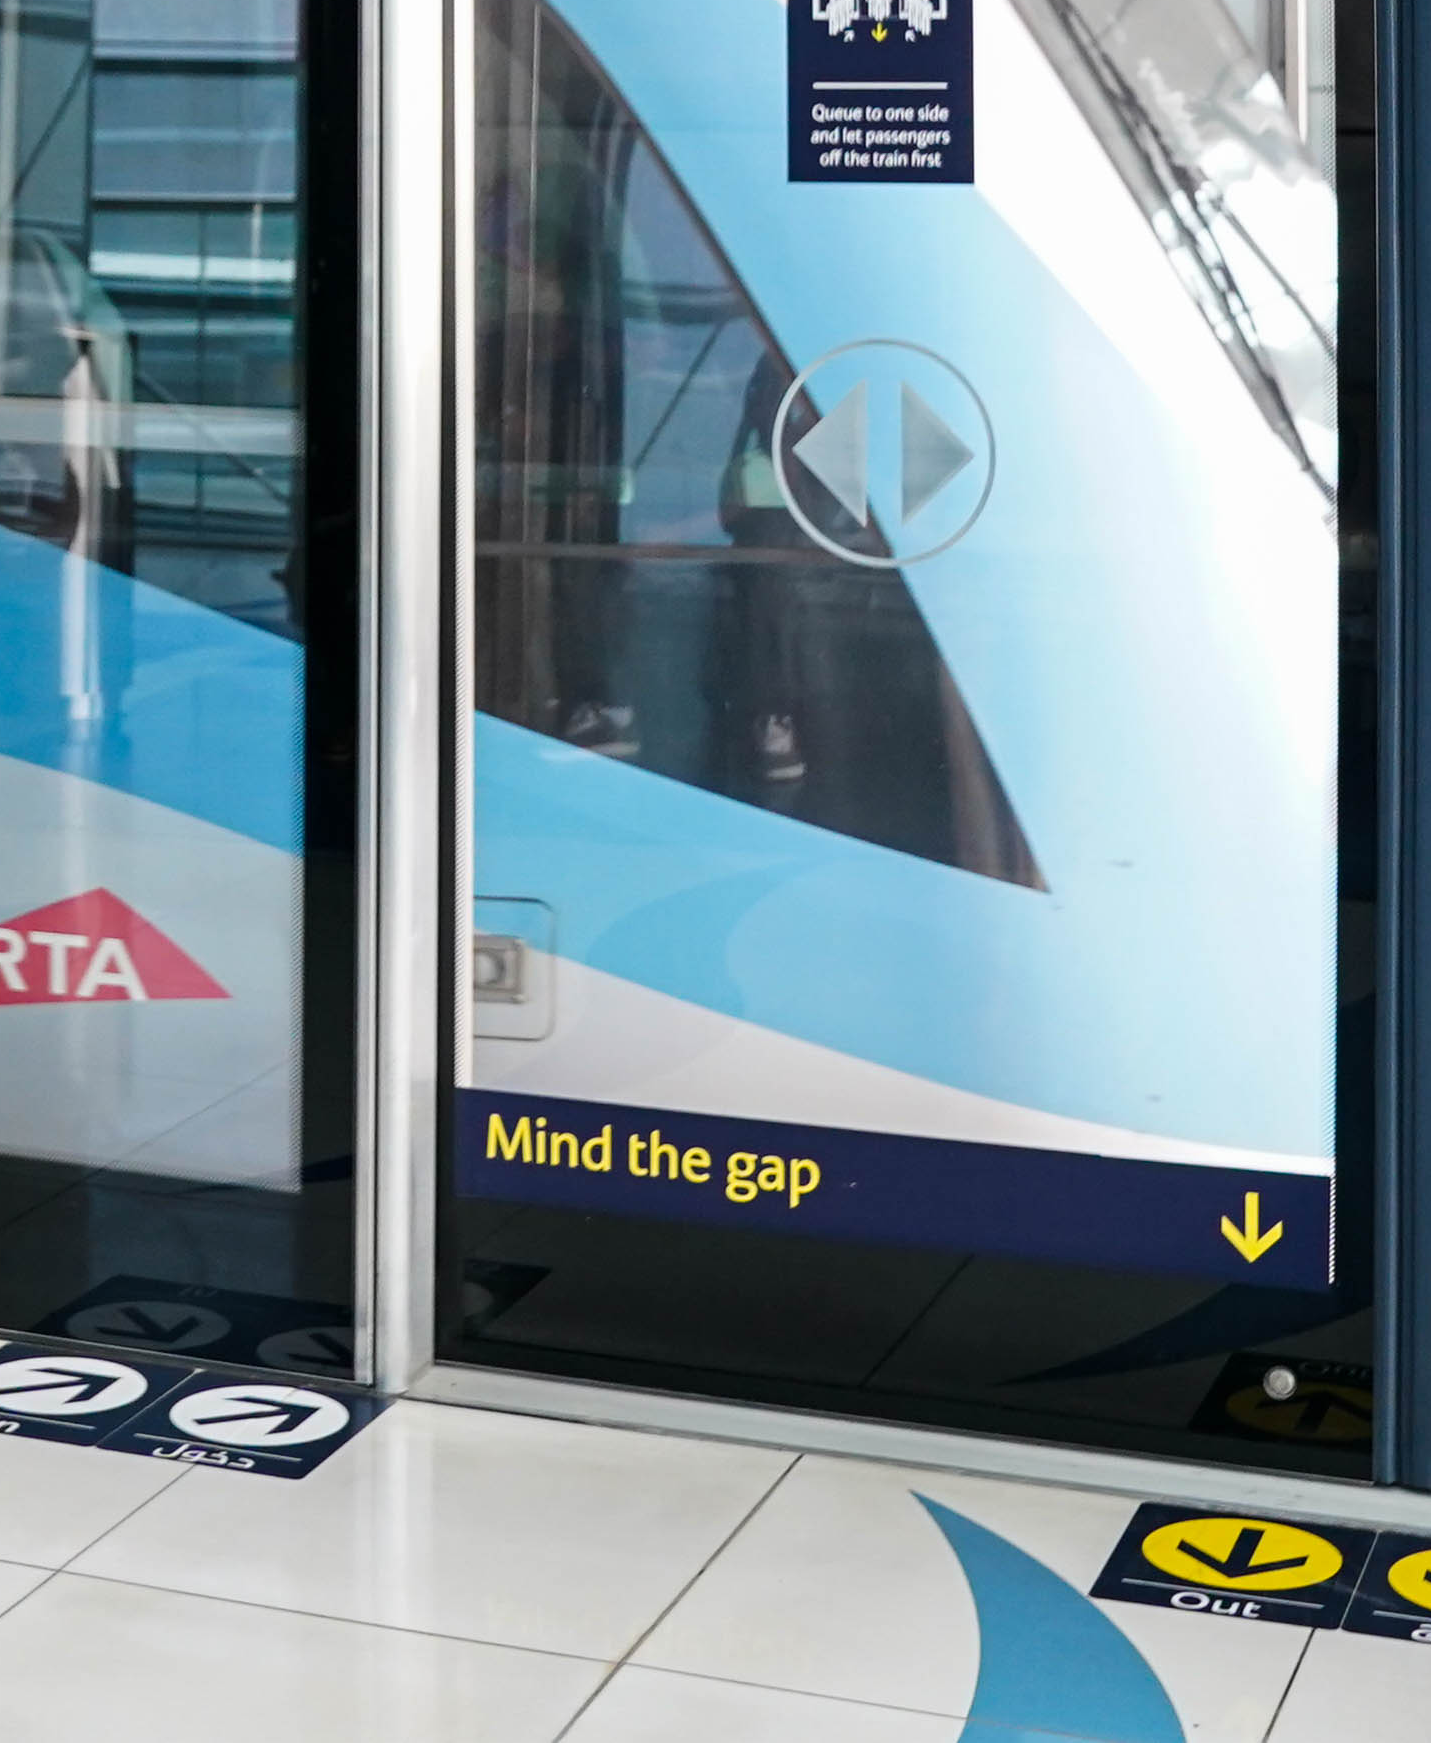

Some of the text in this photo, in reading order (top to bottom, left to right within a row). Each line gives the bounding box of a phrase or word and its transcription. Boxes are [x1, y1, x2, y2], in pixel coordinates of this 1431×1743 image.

[811, 103, 949, 123] Queue to one side
[810, 126, 951, 149] and let passengers
[819, 150, 942, 168] off the train first
[484, 1113, 822, 1209] Mind the gap
[151, 1442, 255, 1470] دخول
[1169, 1590, 1262, 1621] Out
